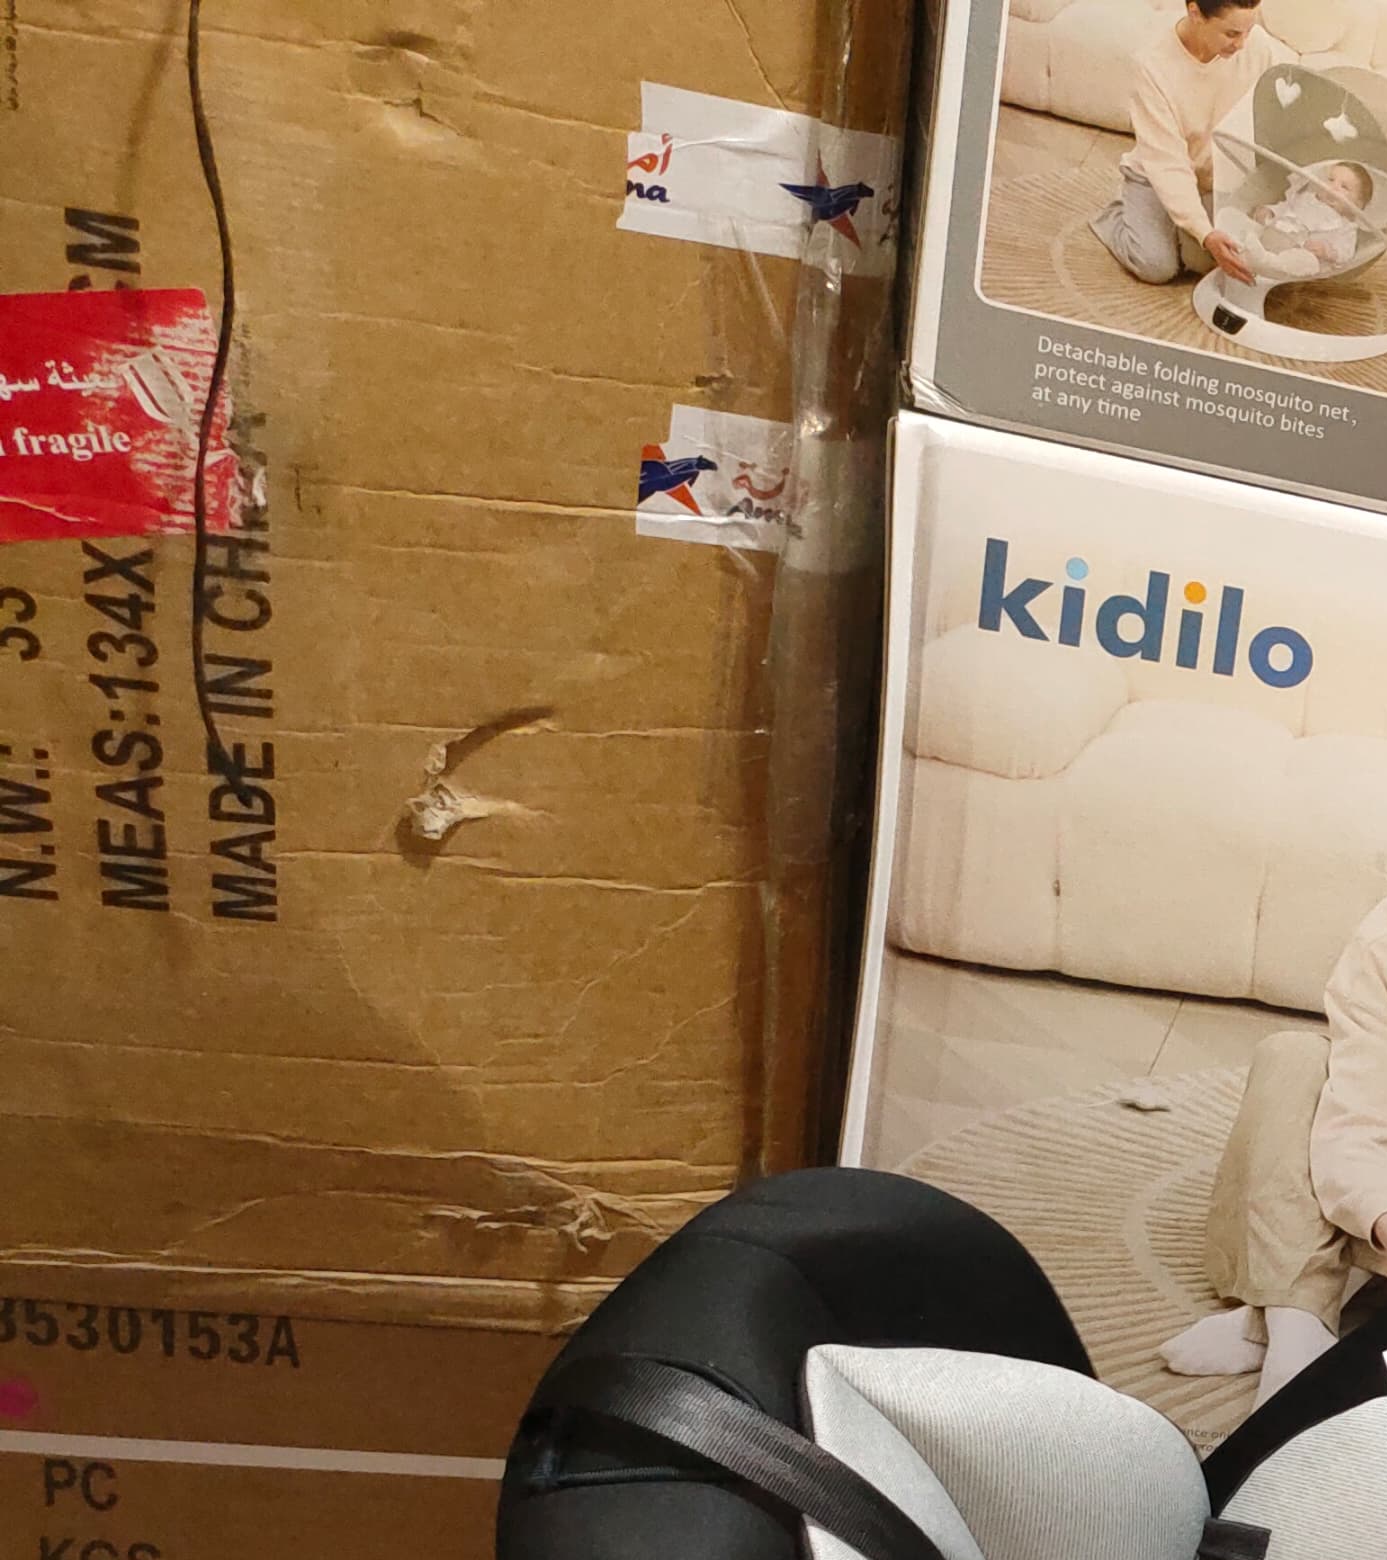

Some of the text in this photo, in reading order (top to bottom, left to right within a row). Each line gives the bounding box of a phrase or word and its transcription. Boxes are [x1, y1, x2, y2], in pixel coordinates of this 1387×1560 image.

[1032, 383, 1142, 422] at any time
[1034, 362, 1325, 439] protect against mosquito bites
[1037, 336, 1148, 376] Detachable
[1153, 360, 1219, 395] folding
[1225, 379, 1313, 413] mosquito
[13, 426, 132, 461] fragile
[978, 537, 1313, 688] kidilo
[204, 653, 278, 922] MADE IN
[43, 1459, 119, 1511] PC
